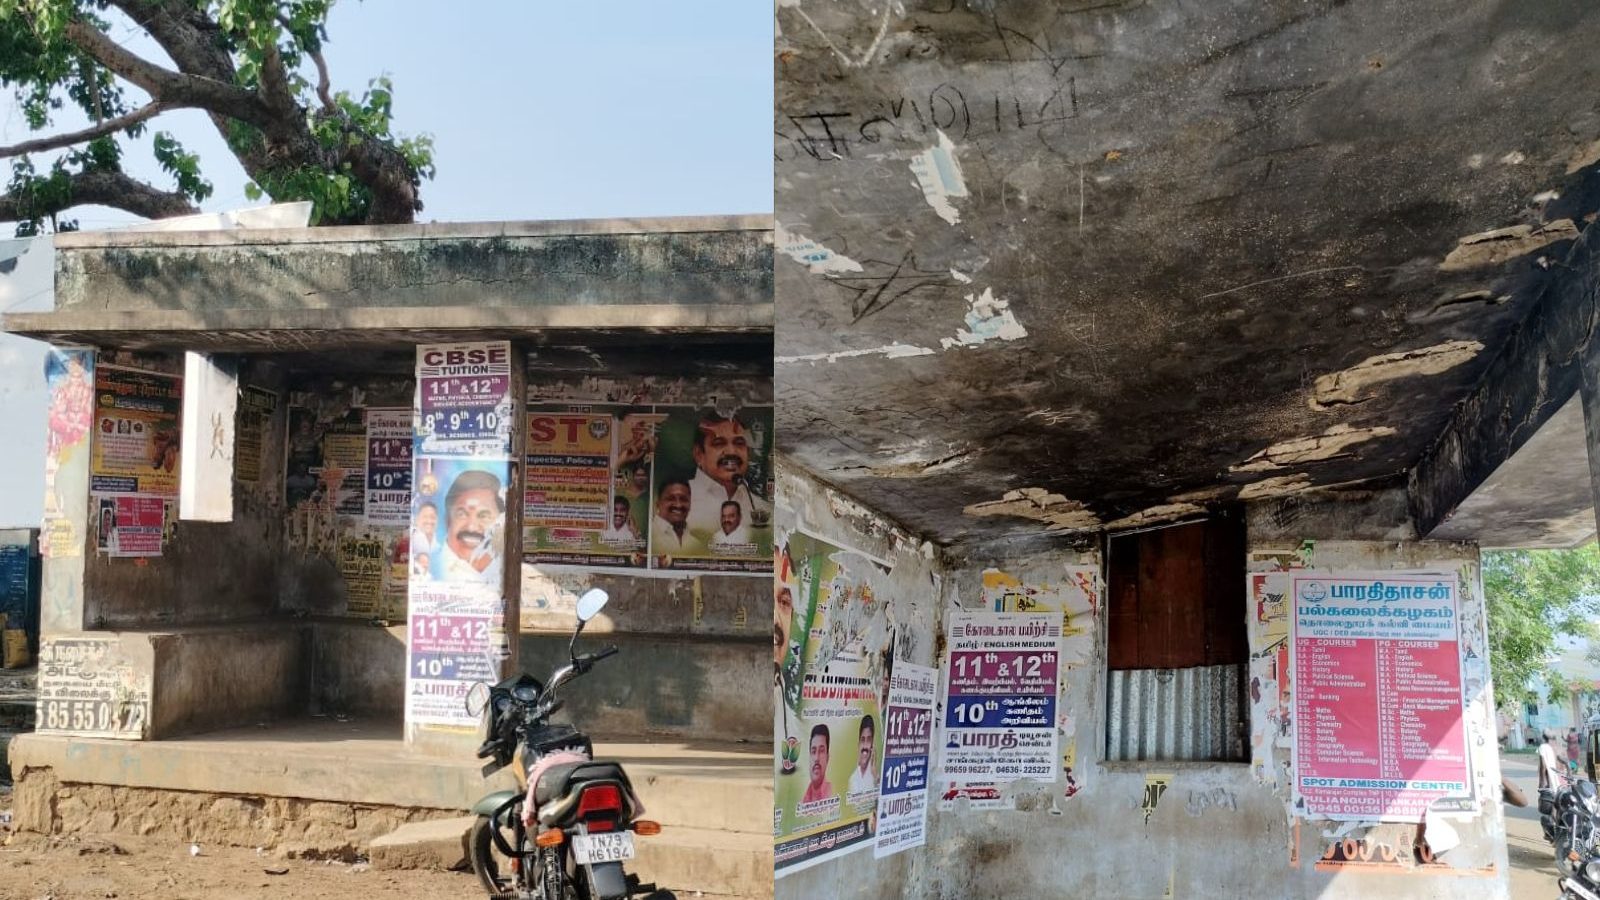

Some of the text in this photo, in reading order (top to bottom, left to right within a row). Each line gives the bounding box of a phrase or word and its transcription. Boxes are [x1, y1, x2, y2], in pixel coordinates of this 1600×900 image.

[424, 349, 506, 366] CBSE
[442, 366, 488, 375] TUITION
[1331, 582, 1450, 602] பாரதிதாசன்
[1299, 604, 1453, 621] பல்கலைக்கழகம்
[965, 622, 1047, 638] கோடைகால பயிற்சி
[956, 641, 979, 649] தமிழ்
[955, 653, 1055, 676] 11th & 12th
[954, 700, 998, 723] 10th
[962, 729, 1018, 750] பாரத்
[1303, 778, 1462, 790] SPOT ADMISSION CENTRE
[591, 834, 622, 848] TN79
